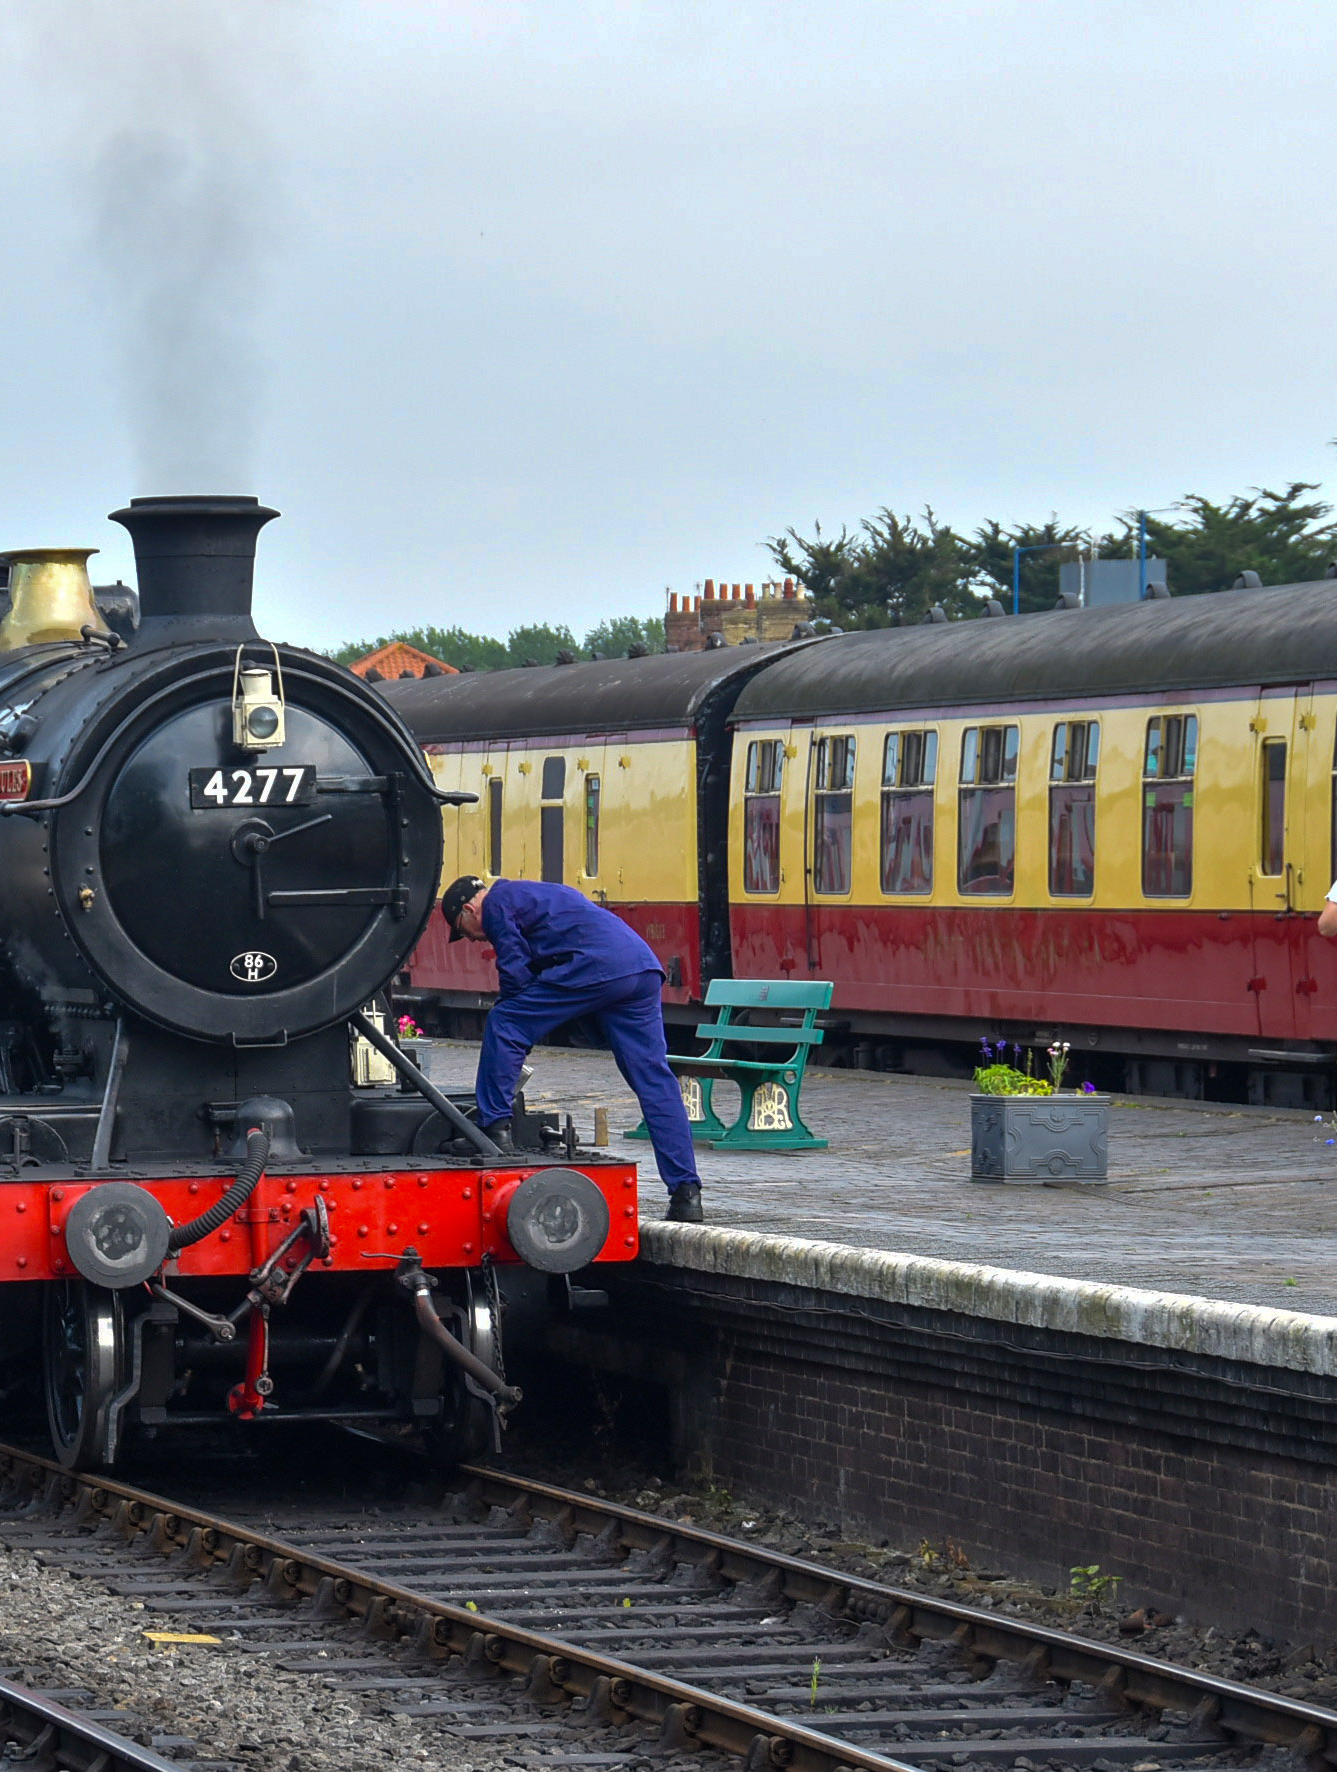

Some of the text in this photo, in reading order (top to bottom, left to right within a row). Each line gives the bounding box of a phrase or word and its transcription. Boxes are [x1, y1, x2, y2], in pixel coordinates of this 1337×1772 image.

[203, 768, 305, 804] 4277
[244, 954, 264, 968] 86
[247, 968, 258, 980] H
